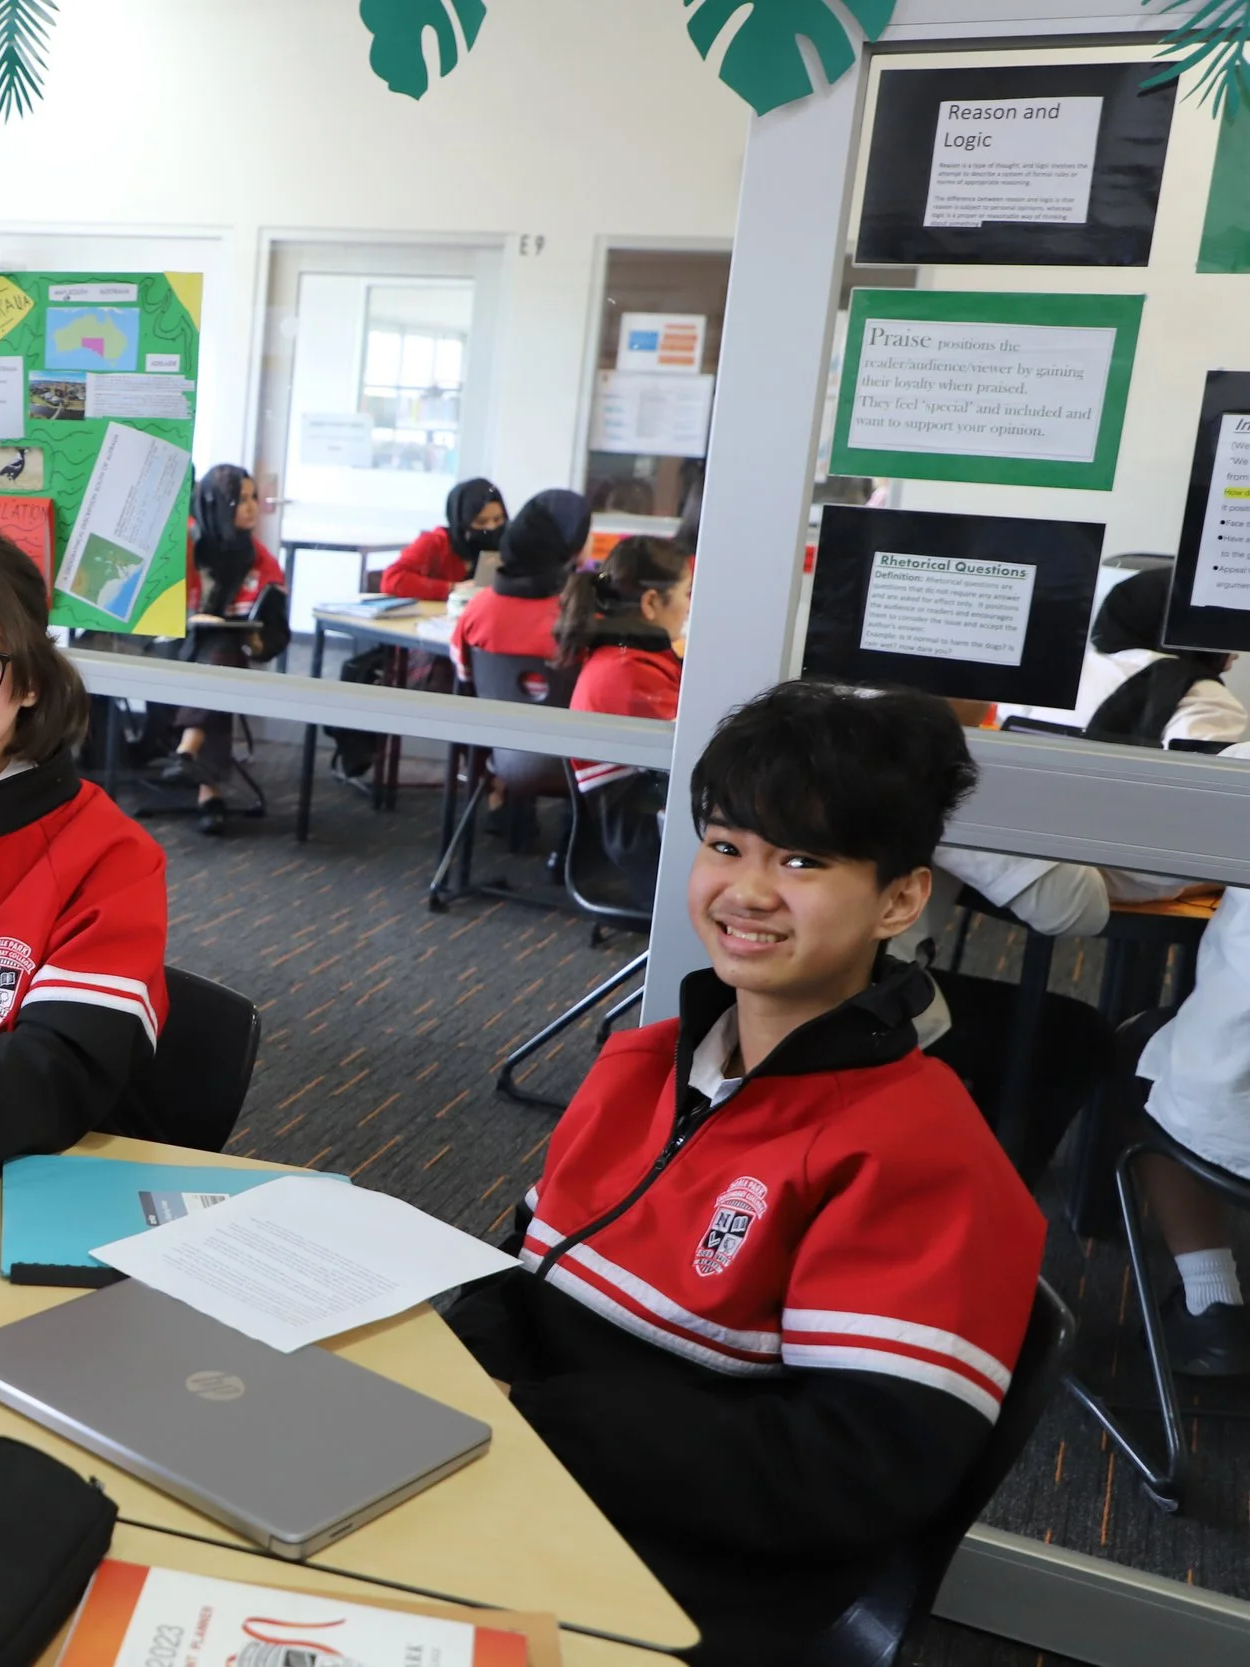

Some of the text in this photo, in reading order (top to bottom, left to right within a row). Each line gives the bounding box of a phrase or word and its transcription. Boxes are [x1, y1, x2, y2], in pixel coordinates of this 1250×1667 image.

[948, 103, 1061, 120] Reason and
[944, 132, 993, 151] Logic
[869, 327, 1021, 353] Praise positions the
[863, 358, 1084, 379] reader/audience/viewer by gaining
[861, 374, 1028, 396] their loyalty when praised.
[859, 395, 891, 410] They
[895, 396, 918, 410] feel
[976, 402, 1000, 415] and
[1004, 404, 1062, 419] included
[1066, 407, 1092, 420] and
[855, 416, 1045, 437] want to support your opinion.
[880, 555, 1027, 578] Rhetorical Questions
[8, 940, 28, 954] PARK
[716, 1213, 731, 1228] N
[185, 1370, 246, 1400] hp
[190, 1605, 213, 1650] PLANNER
[144, 1624, 184, 1667] 2023
